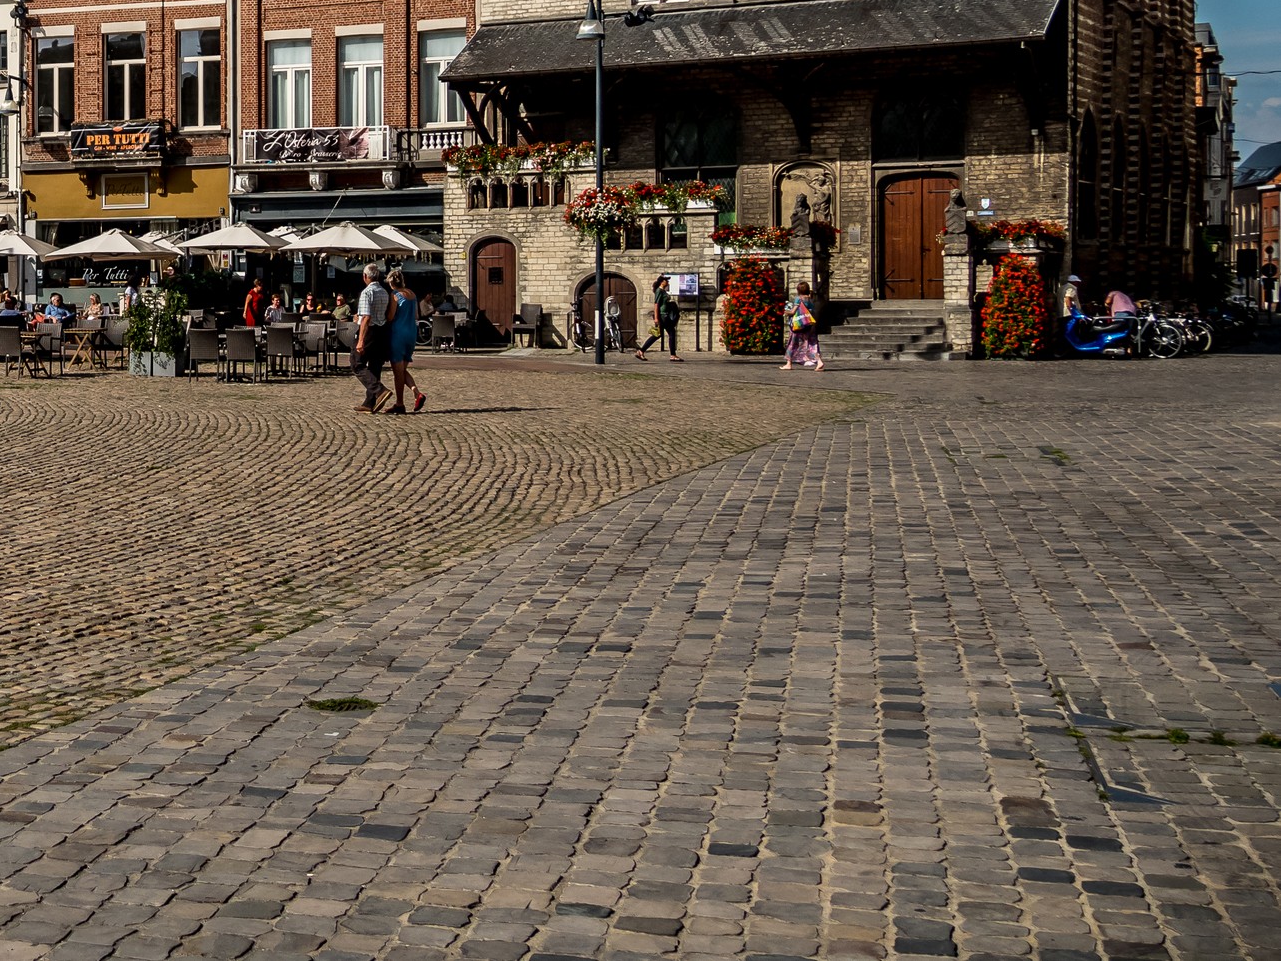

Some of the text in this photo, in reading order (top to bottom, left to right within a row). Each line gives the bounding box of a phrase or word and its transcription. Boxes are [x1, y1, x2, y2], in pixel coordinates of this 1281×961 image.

[86, 132, 150, 146] PER TUTTI
[263, 131, 339, 152] L'Osteria 53
[82, 266, 129, 280] Per Tutti
